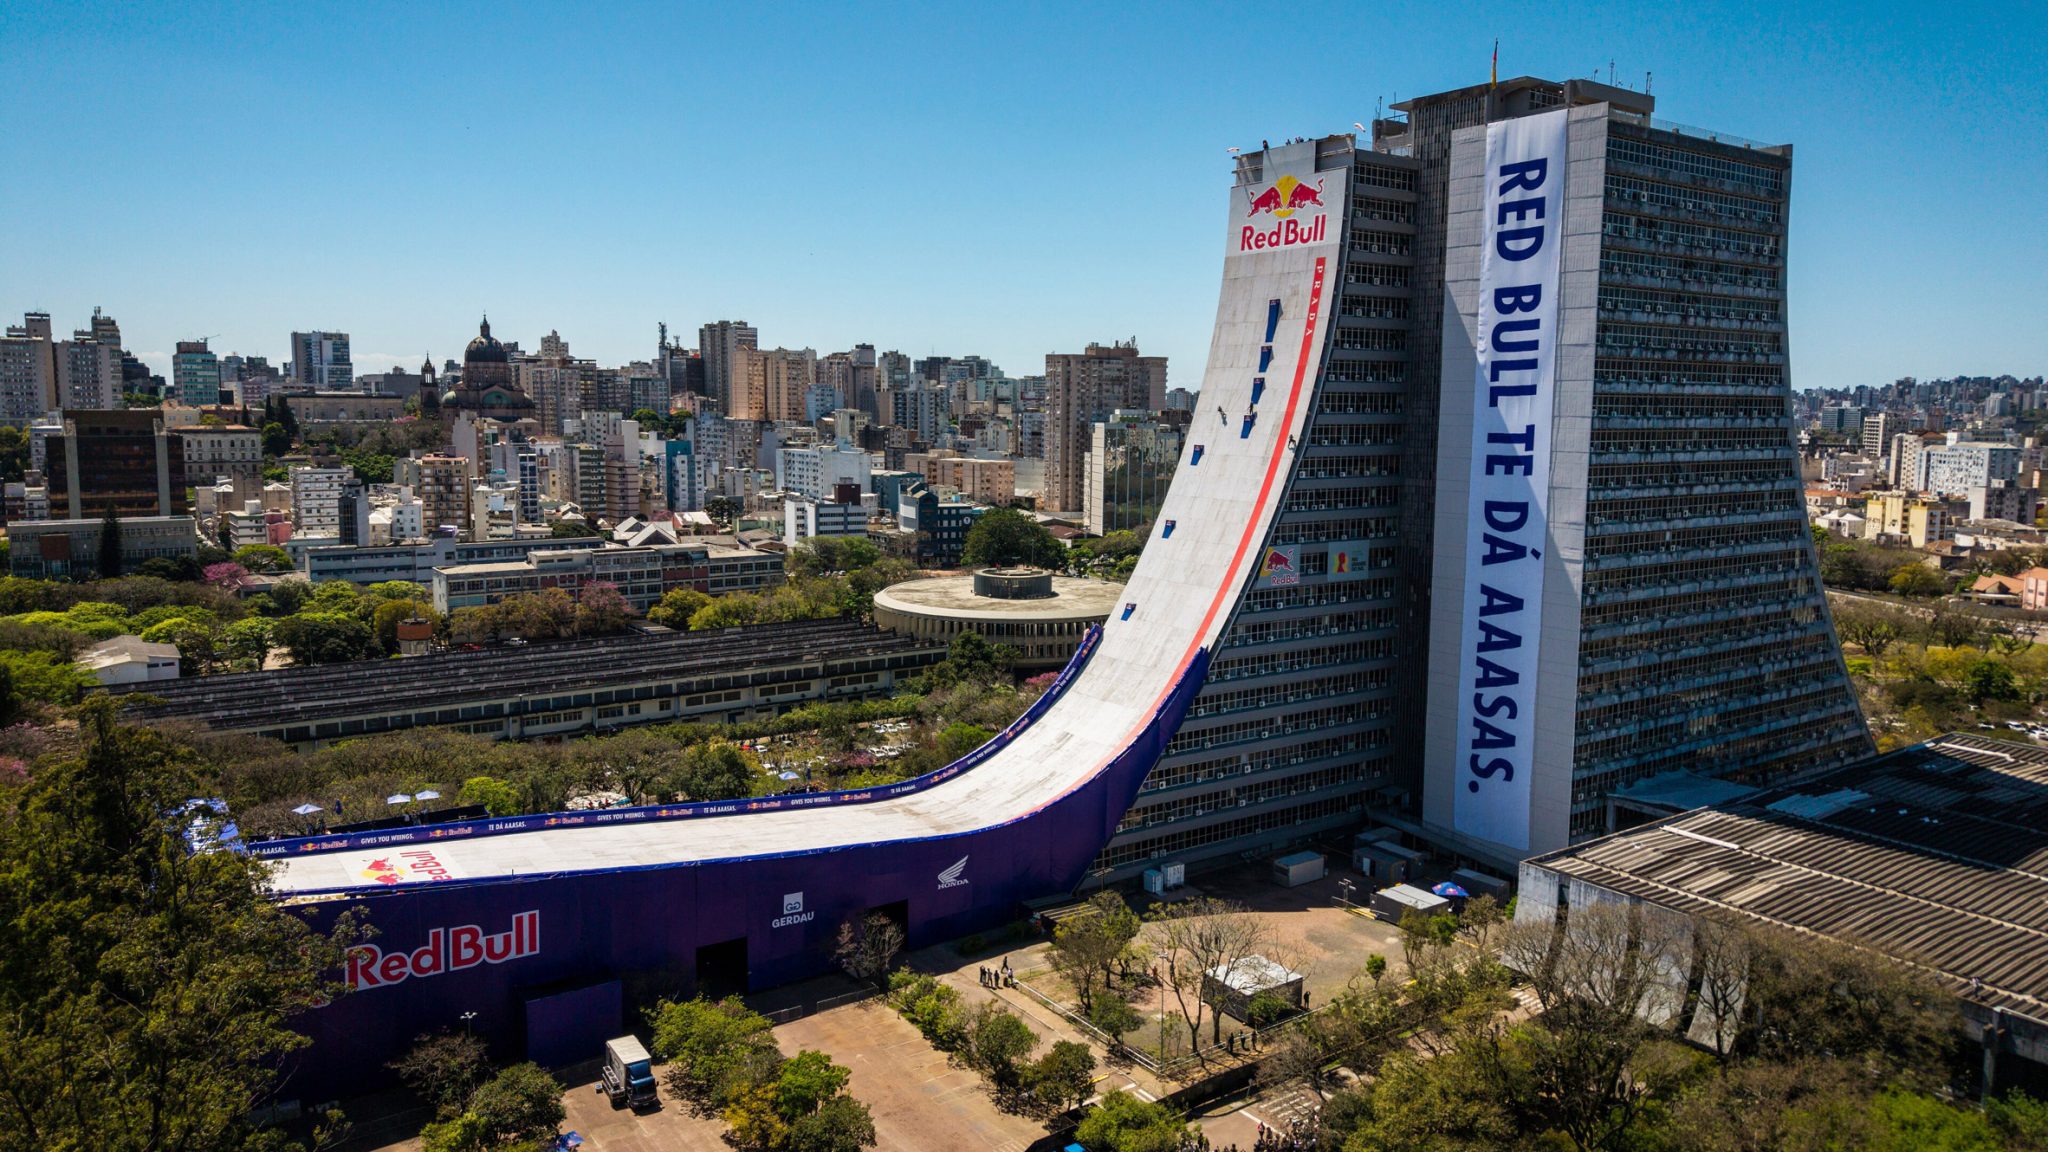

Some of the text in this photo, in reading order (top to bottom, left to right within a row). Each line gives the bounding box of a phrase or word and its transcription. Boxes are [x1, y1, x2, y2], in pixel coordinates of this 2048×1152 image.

[1240, 214, 1327, 251] Red Bull
[1306, 265, 1324, 336] PRADA
[1468, 157, 1547, 793] RED BULL TE DÁ AAASAS.
[1271, 574, 1287, 585] Red
[360, 837, 377, 845] GIVES
[378, 835, 390, 843] YOU
[400, 850, 453, 881] ed Bull
[937, 879, 969, 890] HONDA
[771, 911, 815, 929] GERDAU
[345, 909, 540, 991] Red Bull
